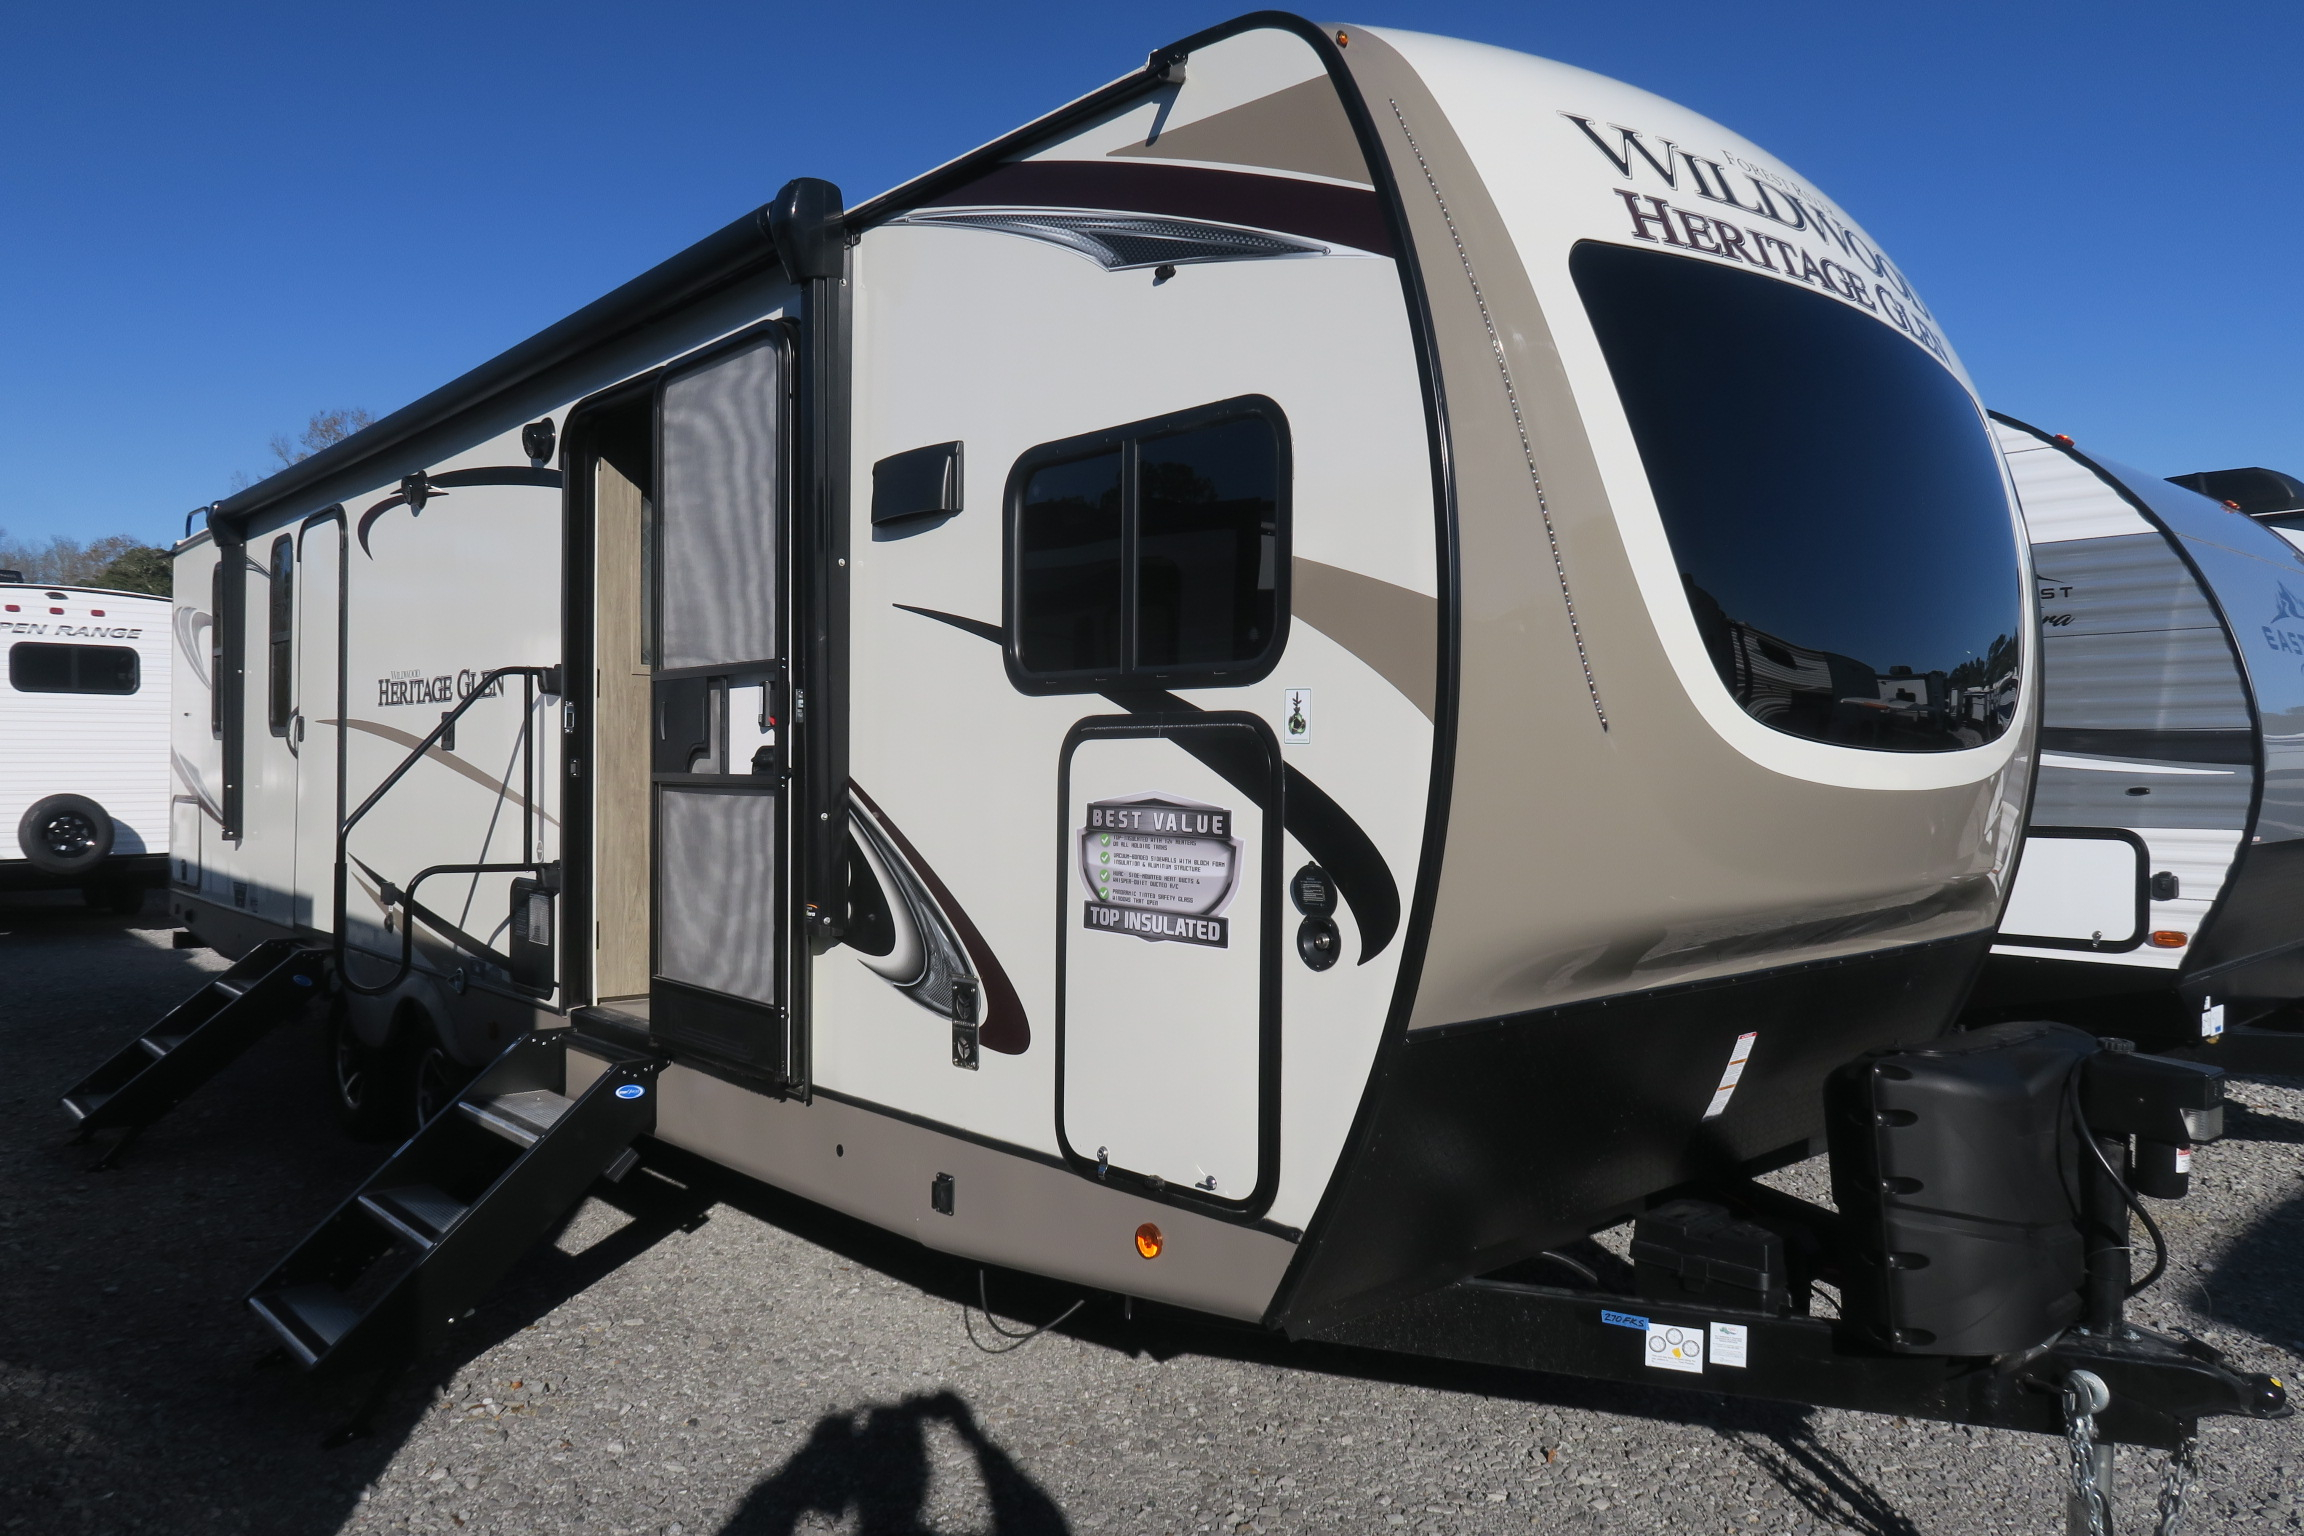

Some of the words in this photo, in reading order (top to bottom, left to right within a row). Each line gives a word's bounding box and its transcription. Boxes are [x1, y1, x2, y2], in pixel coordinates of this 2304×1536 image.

[1555, 110, 1931, 322] WILDWOOD
[1612, 187, 1878, 315] HERITAGE
[1874, 283, 1954, 371] GLEN
[54, 625, 143, 640] RANGE
[377, 674, 454, 708] HERITAGE
[1092, 809, 1142, 829] BEST
[1153, 811, 1224, 835] VALUE
[1090, 906, 1120, 927] TOP
[1124, 911, 1221, 942] INSULATED
